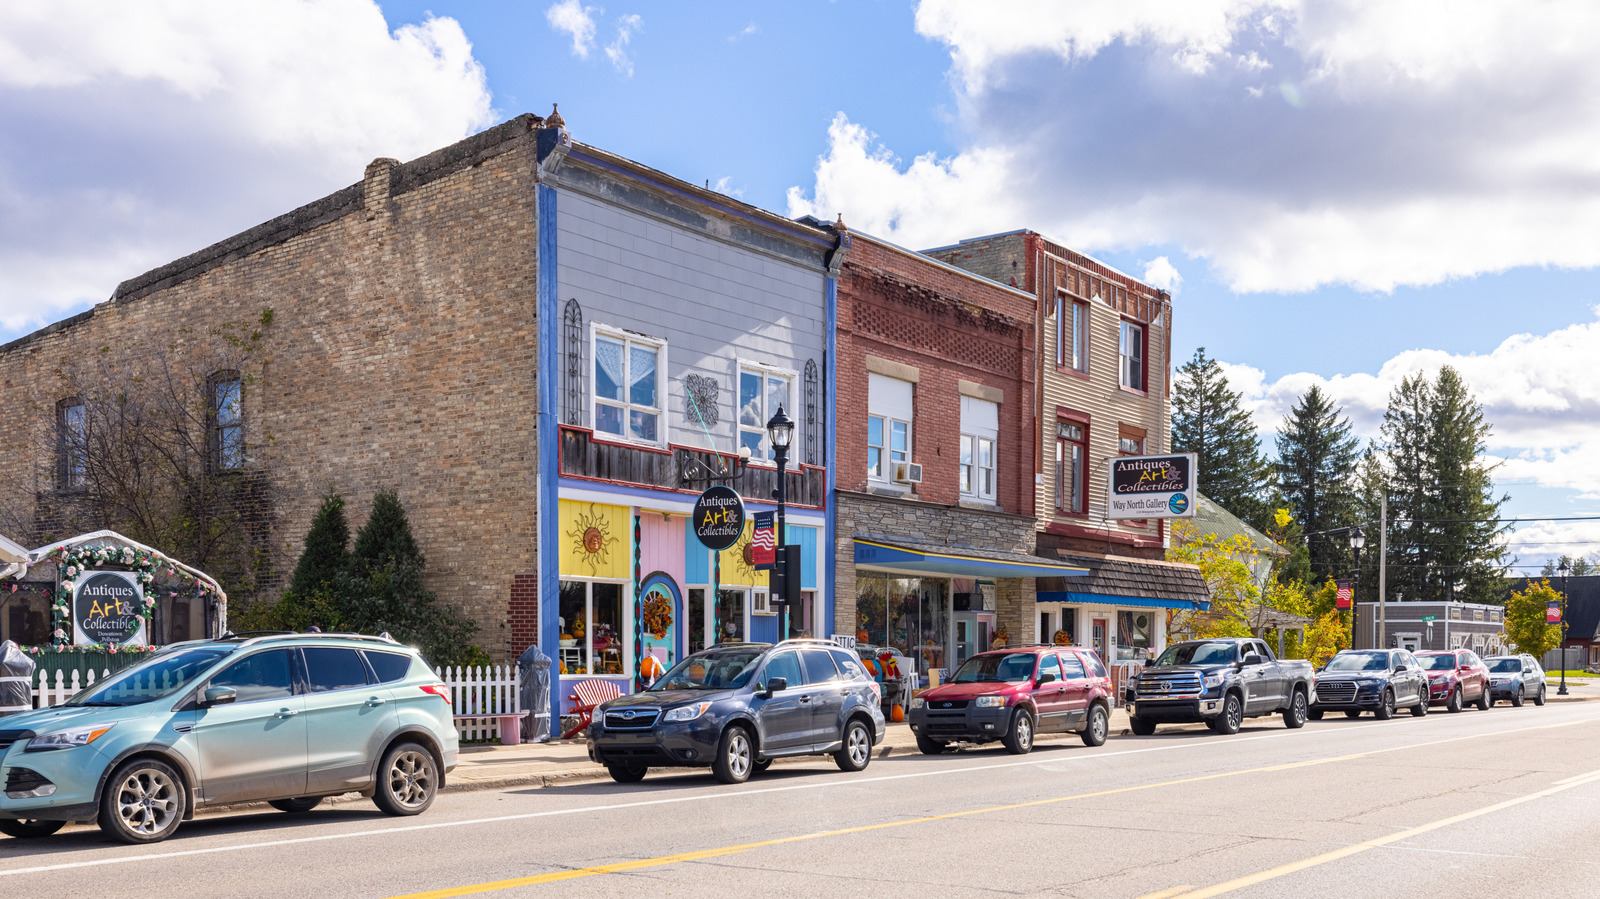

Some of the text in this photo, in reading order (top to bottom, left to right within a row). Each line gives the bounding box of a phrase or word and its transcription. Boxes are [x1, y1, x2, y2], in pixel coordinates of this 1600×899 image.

[1117, 460, 1171, 472] Antiques
[1117, 480, 1184, 493] Collectibles
[699, 495, 738, 509] Antiques
[1113, 498, 1168, 511] Way North Gallery
[697, 523, 739, 536] Collectibles
[83, 583, 134, 600] Antiques
[83, 615, 134, 630] Collectible
[834, 636, 855, 649] ATTIC
